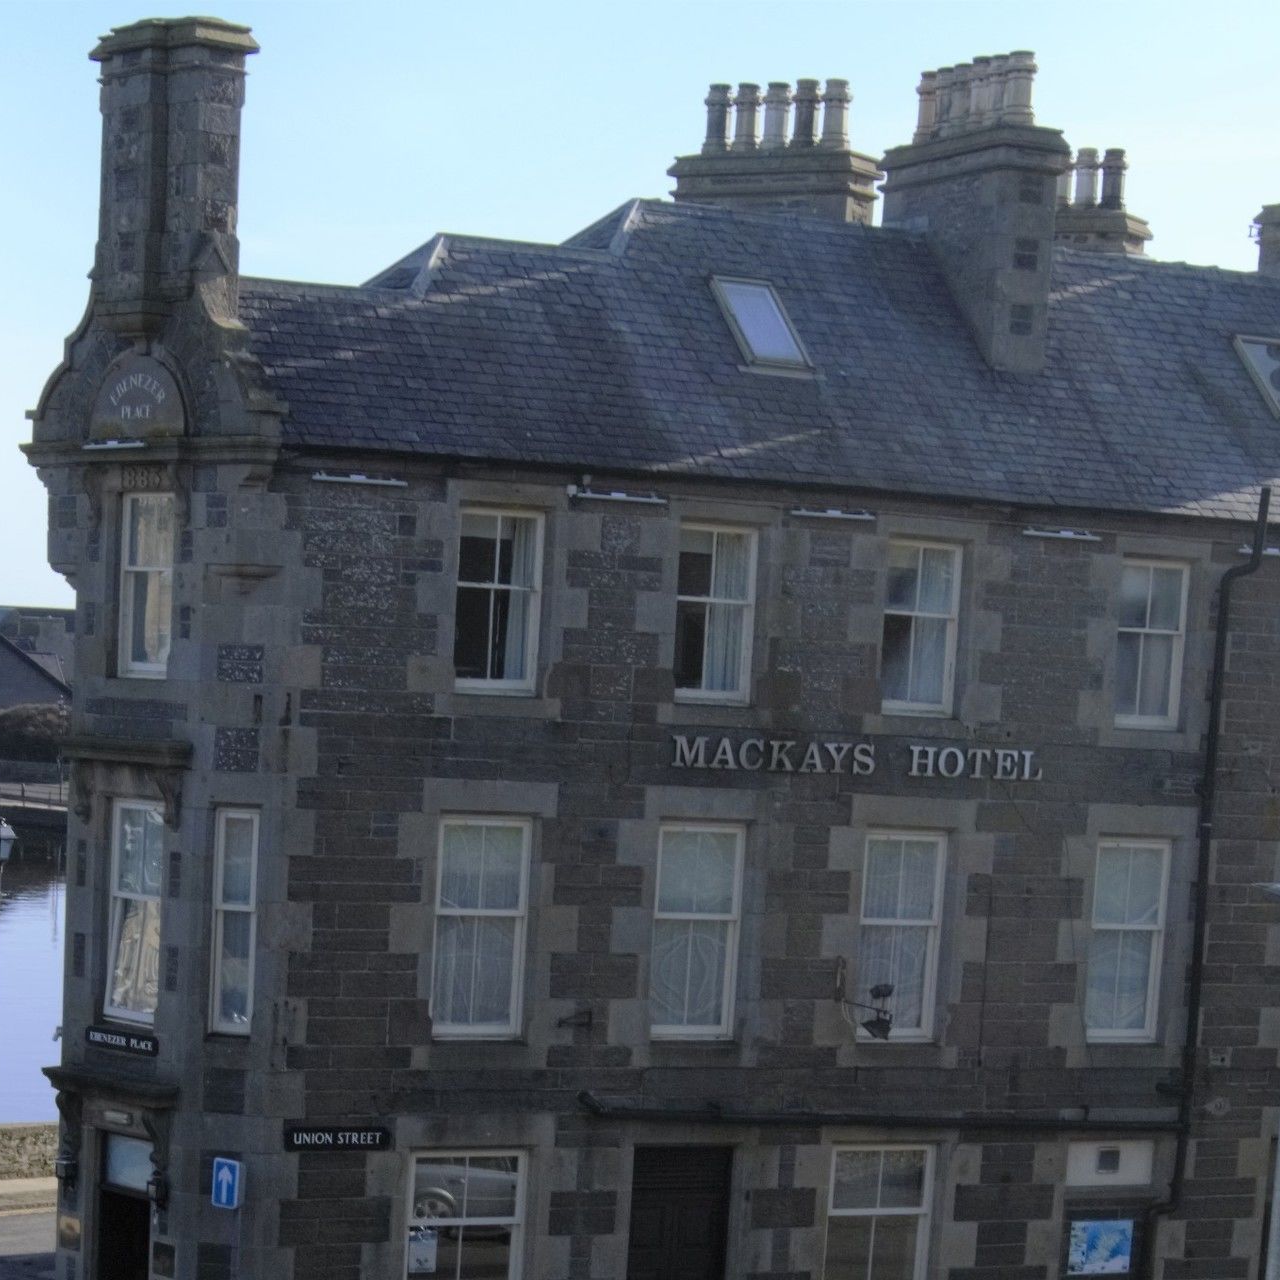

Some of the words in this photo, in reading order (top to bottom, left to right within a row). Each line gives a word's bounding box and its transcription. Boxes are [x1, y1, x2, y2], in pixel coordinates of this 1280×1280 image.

[670, 734, 877, 777] MACKAYS
[907, 743, 1044, 782] HOTEL
[89, 1030, 127, 1046] EBENEZER
[129, 1037, 153, 1051] PLACE
[292, 1131, 333, 1145] UNION
[337, 1131, 382, 1145] STREET
